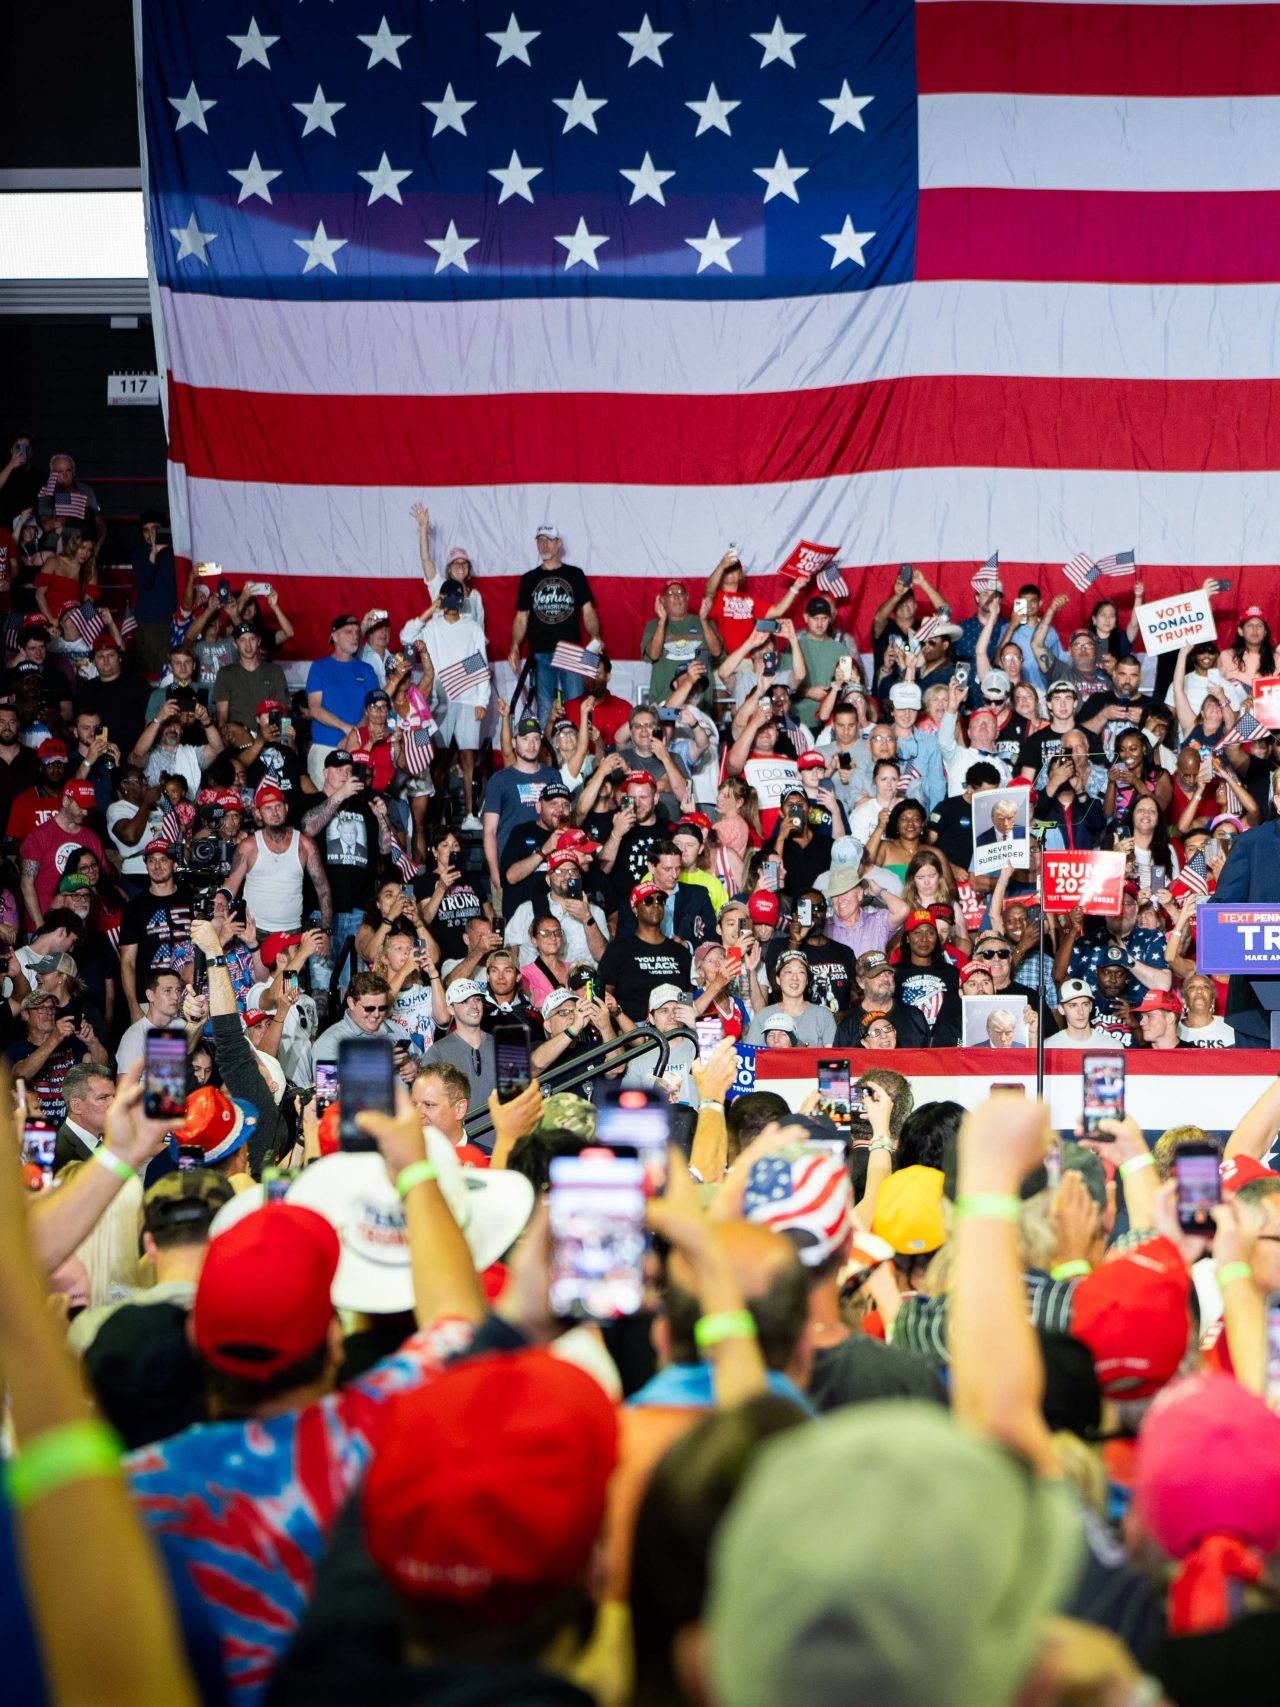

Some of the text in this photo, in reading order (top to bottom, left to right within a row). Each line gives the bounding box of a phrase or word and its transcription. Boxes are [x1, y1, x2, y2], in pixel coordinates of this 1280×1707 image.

[121, 379, 148, 393] 117
[1156, 602, 1192, 619] VOTE
[1149, 612, 1205, 633] DONALD
[1156, 624, 1203, 644] TRUMP
[755, 769, 782, 779] TOO
[767, 784, 781, 796] TO
[35, 809, 59, 827] JES
[987, 844, 1013, 855] NEVER
[979, 852, 1024, 864] SURRENDER
[441, 893, 480, 911] TRUMP
[1223, 914, 1250, 922] TEXT
[831, 972, 848, 980] 2024
[397, 993, 428, 1007] RUMP
[652, 1064, 685, 1074] TUMP
